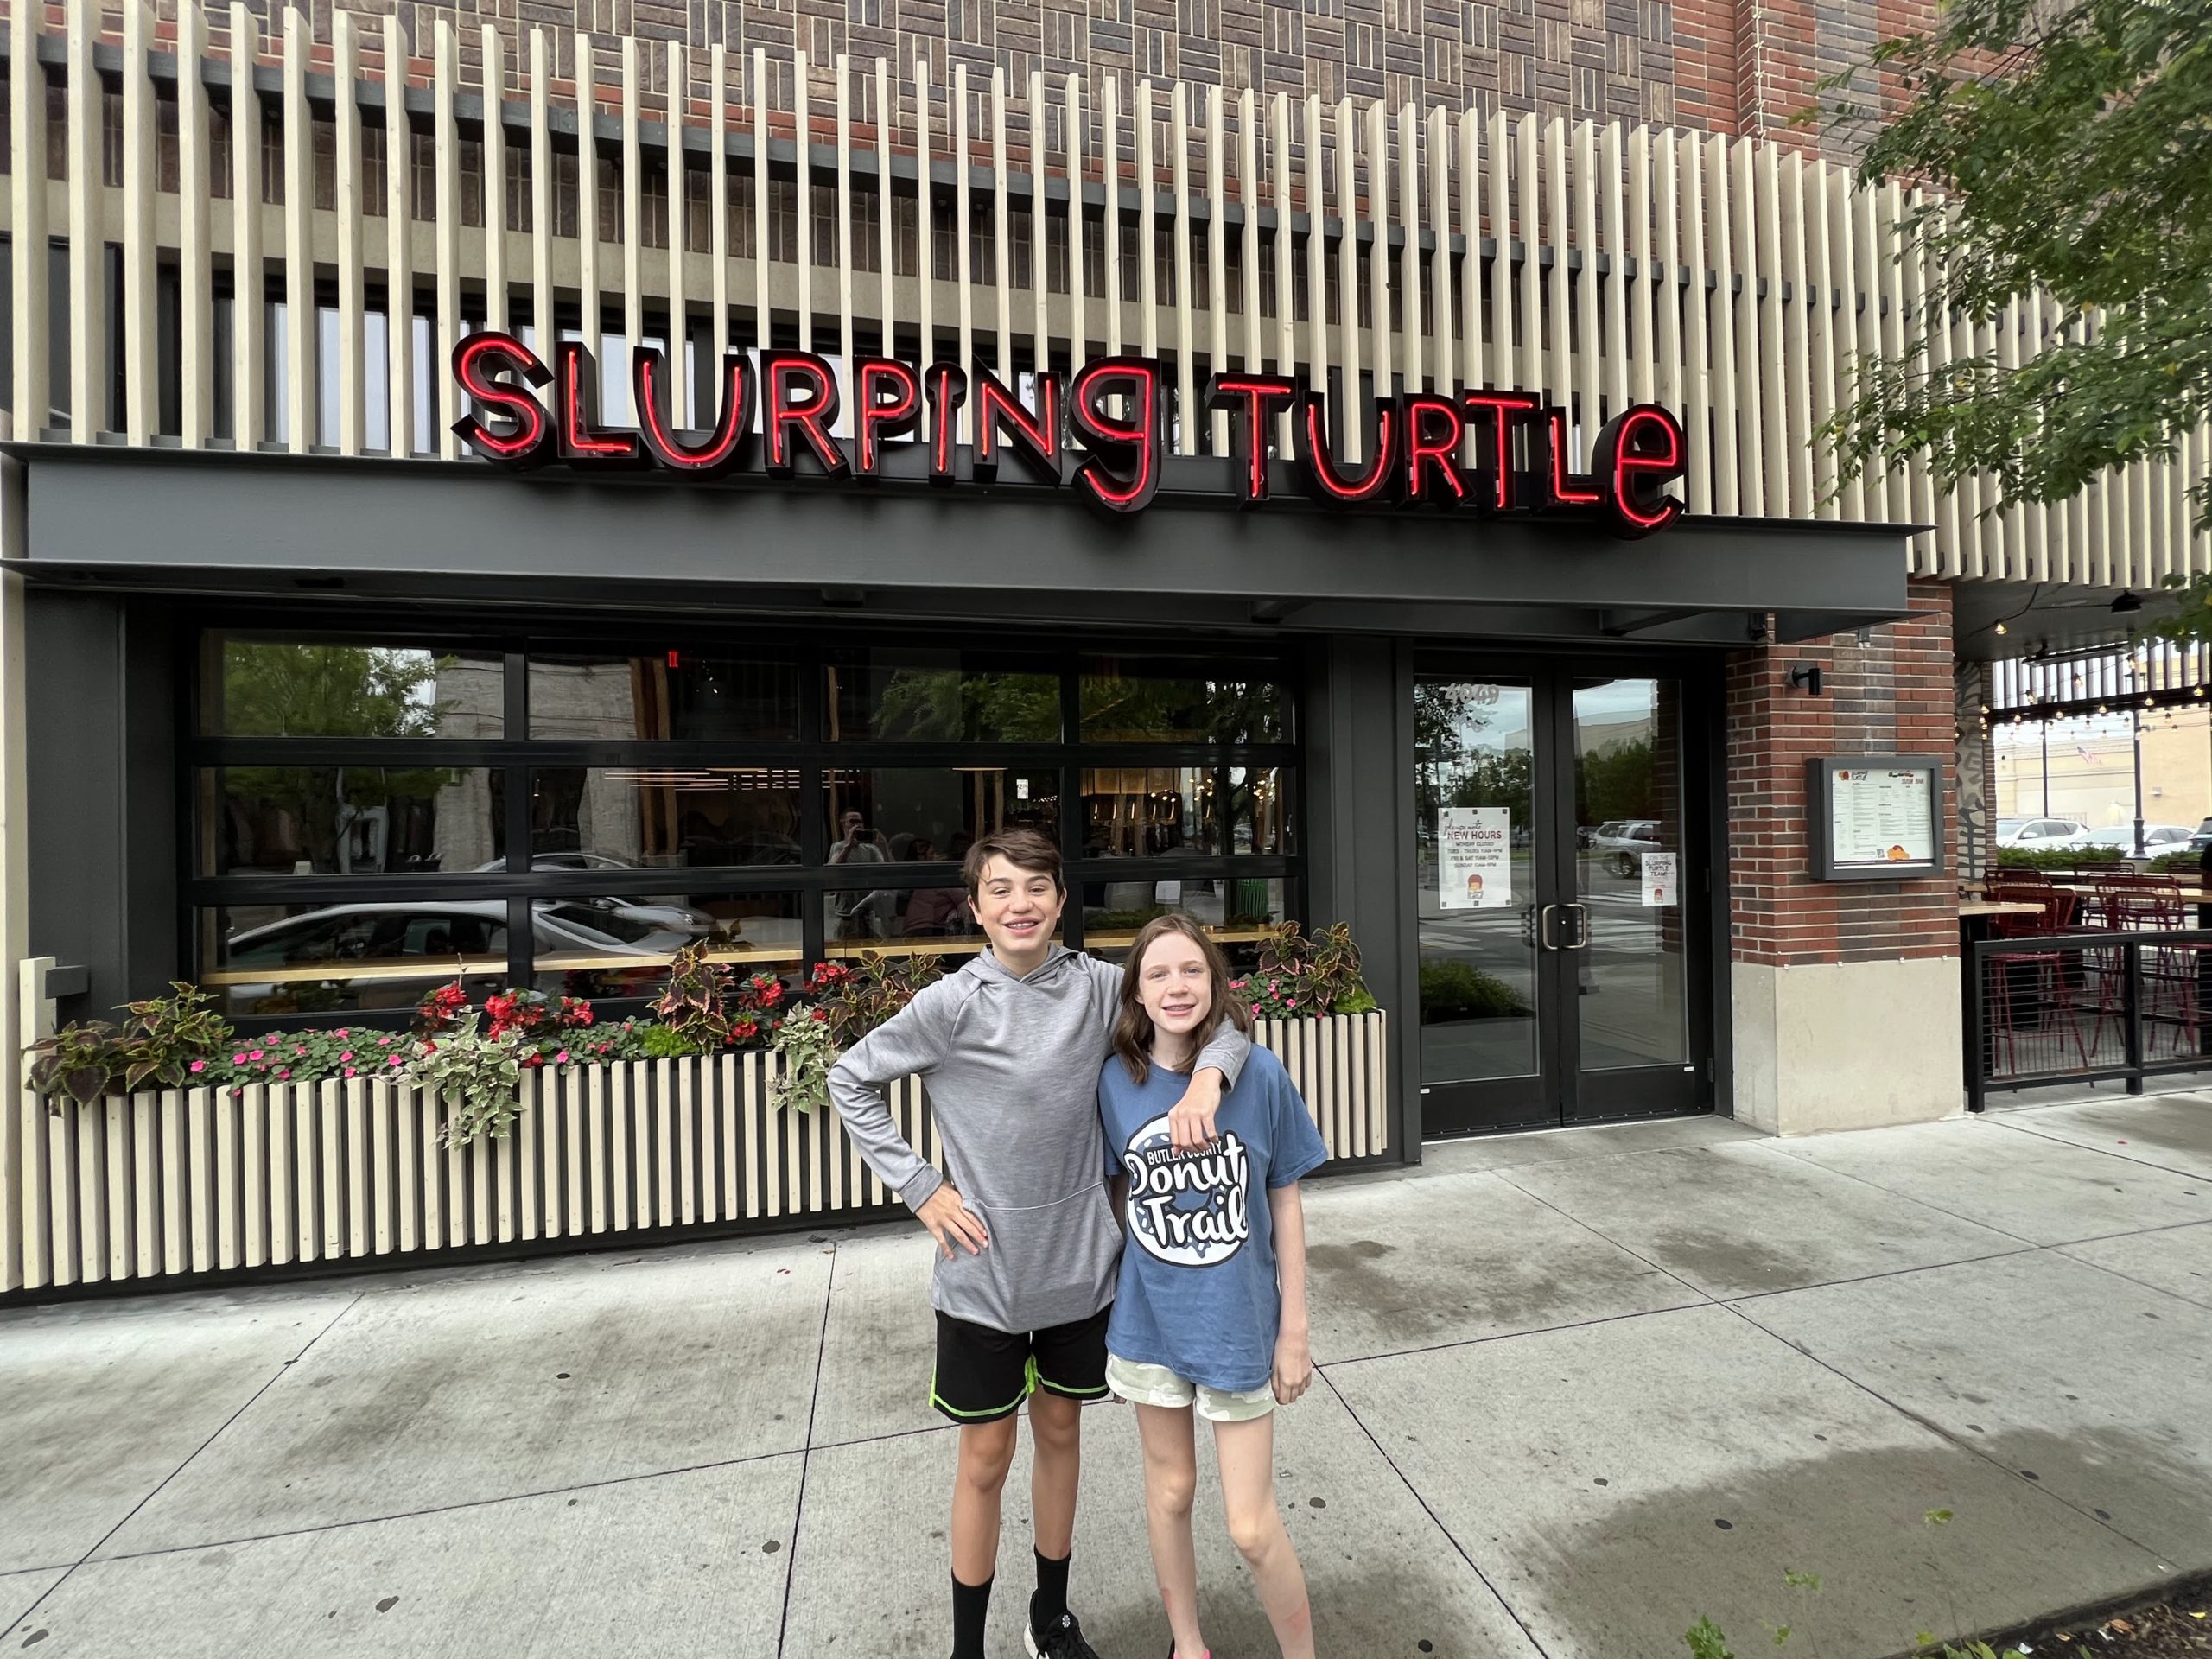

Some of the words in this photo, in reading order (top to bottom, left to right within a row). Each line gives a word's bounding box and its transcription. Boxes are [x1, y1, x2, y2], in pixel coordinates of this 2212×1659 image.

[1444, 683, 1499, 705] 4049
[1447, 830, 1469, 840] NEW
[1471, 830, 1502, 839] HOURS
[1124, 1133, 1244, 1196] Donut
[1142, 1185, 1249, 1247] Trail
